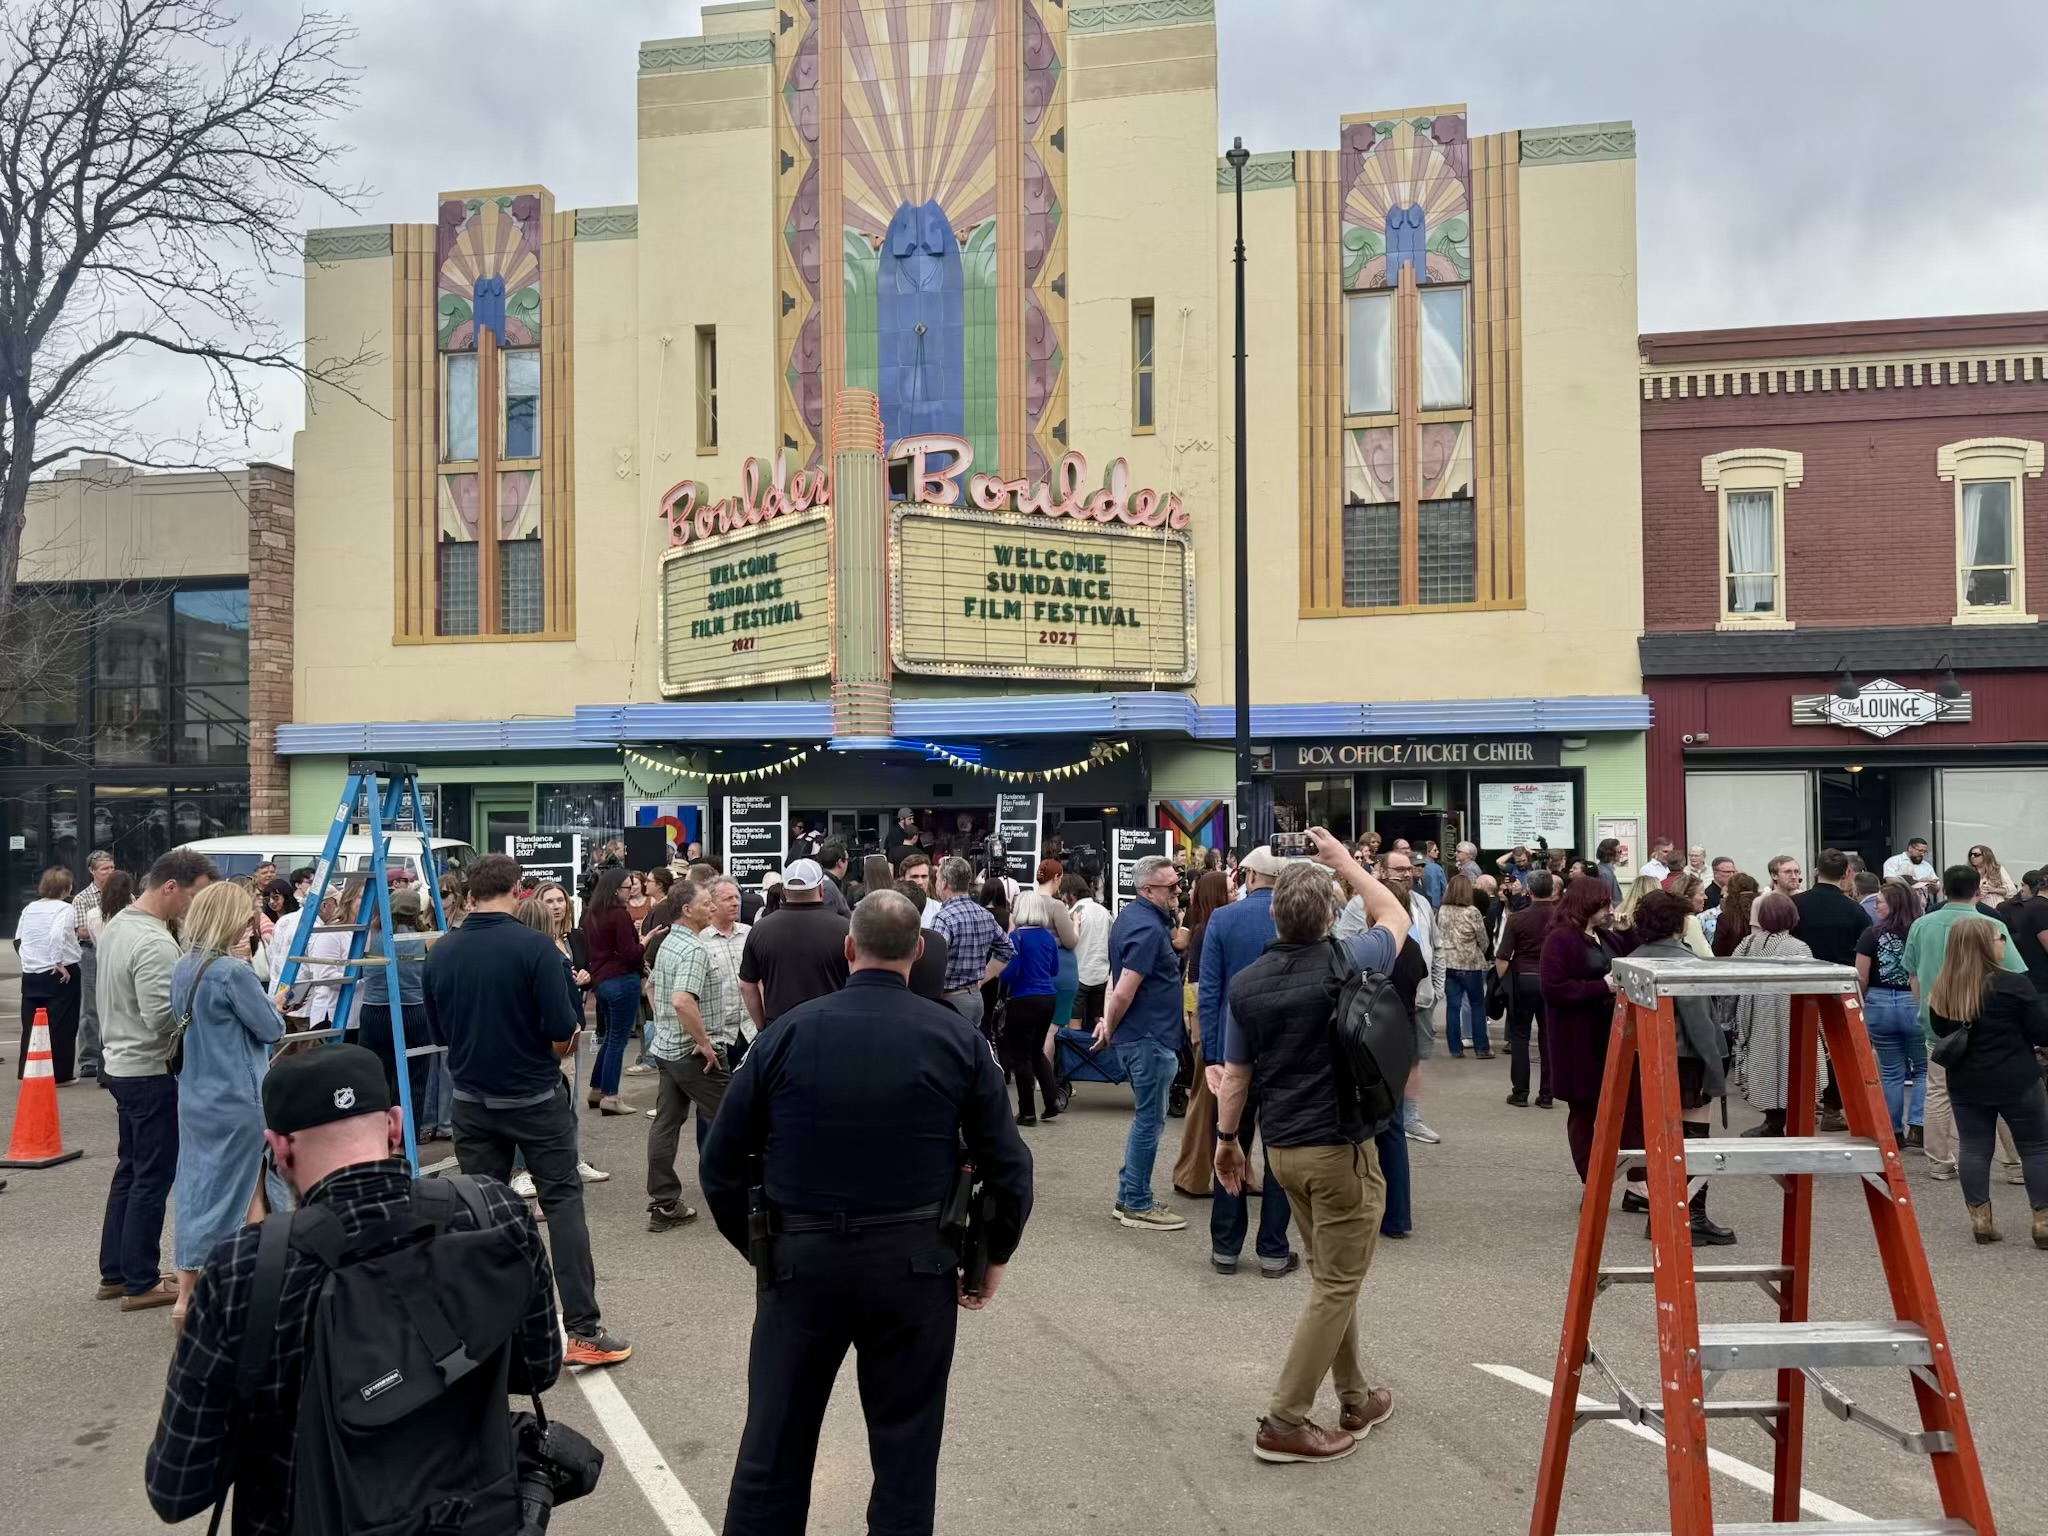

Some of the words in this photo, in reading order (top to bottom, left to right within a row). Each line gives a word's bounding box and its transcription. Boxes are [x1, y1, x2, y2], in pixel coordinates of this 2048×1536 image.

[895, 434, 1190, 529] Boulder
[659, 447, 831, 546] Boulder
[710, 552, 777, 585] WELCOME
[994, 544, 1106, 574] WELCOME
[708, 577, 783, 611] SUNDANCE
[986, 571, 1111, 600] SUNDANCE
[691, 616, 724, 639] FILM
[733, 600, 802, 631] FESTIVAL
[964, 597, 1021, 620] FILM
[1034, 601, 1141, 627] FESTIVAL
[732, 637, 755, 652] 2027
[1039, 631, 1077, 645] 2027
[1837, 701, 1860, 716] The
[1860, 698, 1921, 718] LOUNGE
[1298, 746, 1334, 764] BOX
[1339, 744, 1469, 764] OFFICE/TICKET
[1473, 743, 1534, 761] CENTER
[533, 841, 561, 849] Festival
[1120, 829, 1150, 837] Sundance
